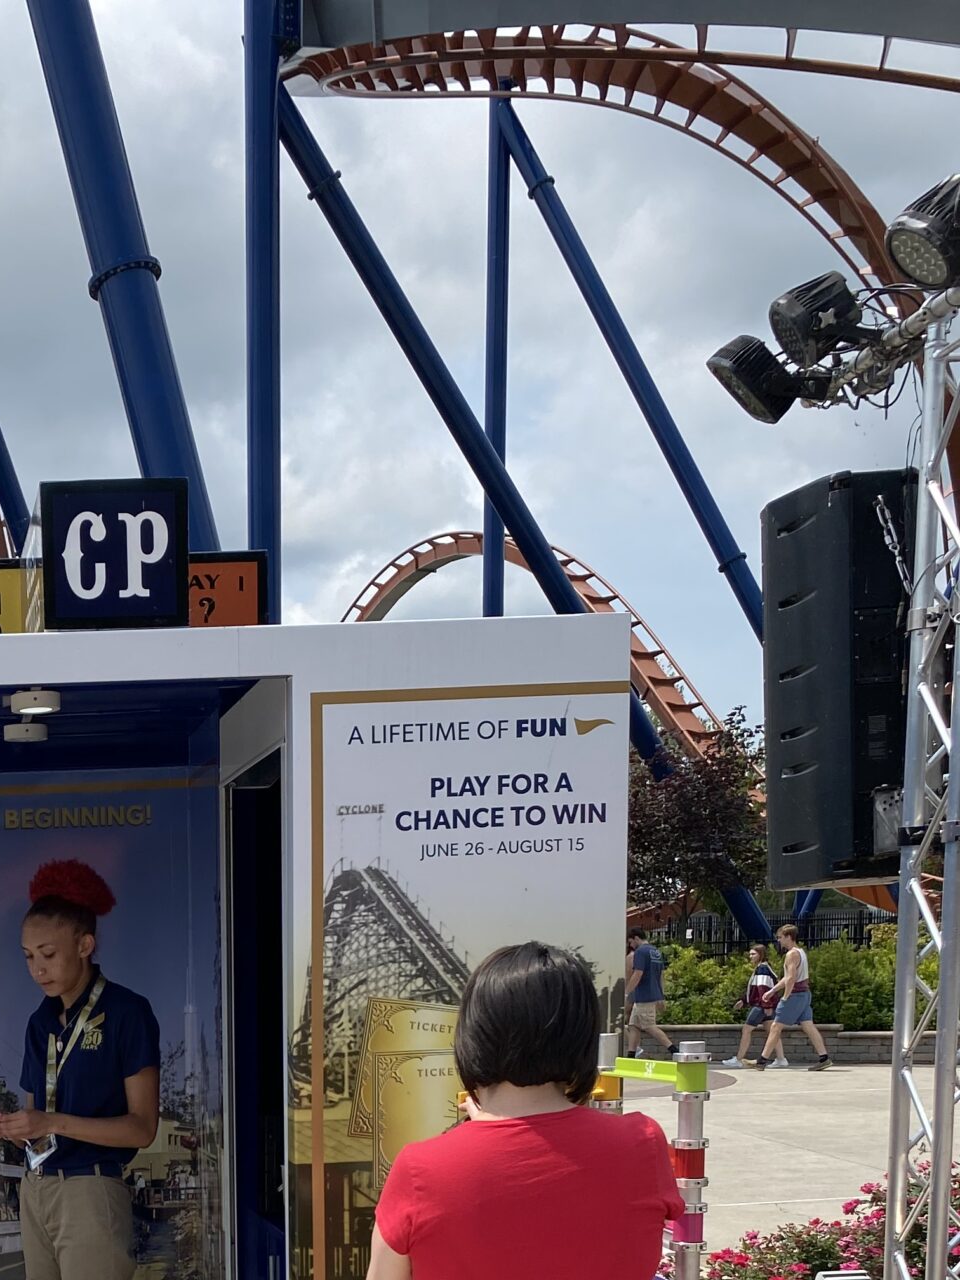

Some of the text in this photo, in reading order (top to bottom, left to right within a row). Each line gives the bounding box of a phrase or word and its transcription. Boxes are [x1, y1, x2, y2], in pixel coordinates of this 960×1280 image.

[62, 510, 169, 599] CP
[190, 574, 220, 590] AY
[348, 717, 567, 745] A LIFETIME OF FUN
[430, 772, 574, 798] PLAY FOR A
[4, 804, 152, 830] BEGINNING!
[337, 803, 385, 816] CYCLONE
[395, 802, 607, 832] CHANCE TO WIN
[419, 843, 459, 861] JUNE
[464, 841, 484, 856] 26
[496, 838, 563, 854] AUGUST
[567, 837, 585, 851] 15
[409, 1020, 454, 1034] TICKET
[416, 1067, 458, 1078] TICKE
